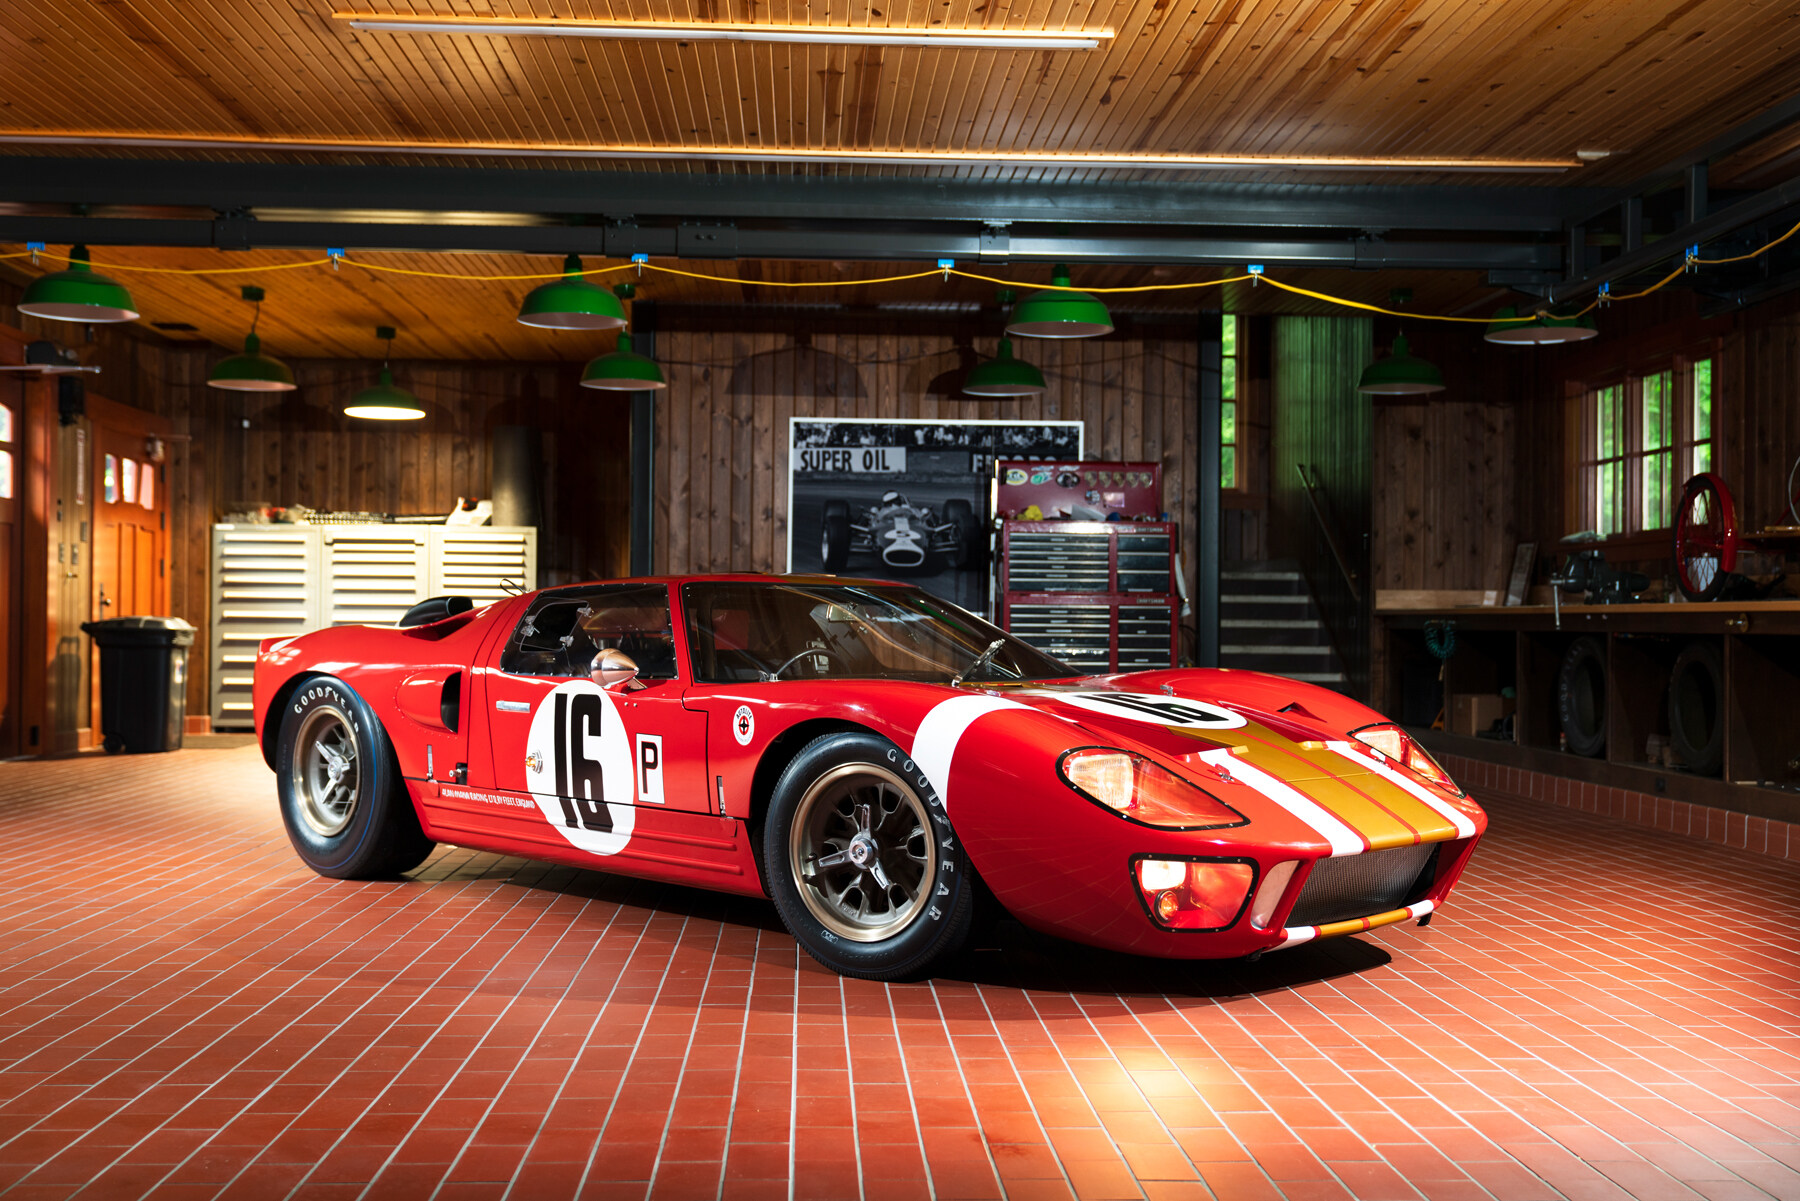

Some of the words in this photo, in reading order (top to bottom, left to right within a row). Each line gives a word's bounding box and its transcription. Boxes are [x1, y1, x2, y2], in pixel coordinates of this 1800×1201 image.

[800, 449, 853, 472] SUPER
[862, 449, 890, 471] OIL
[294, 686, 359, 733] GOODYEAR
[1073, 693, 1230, 724] 16
[554, 692, 614, 834] 16
[641, 740, 658, 794] P
[887, 748, 955, 921] GOODYEAR
